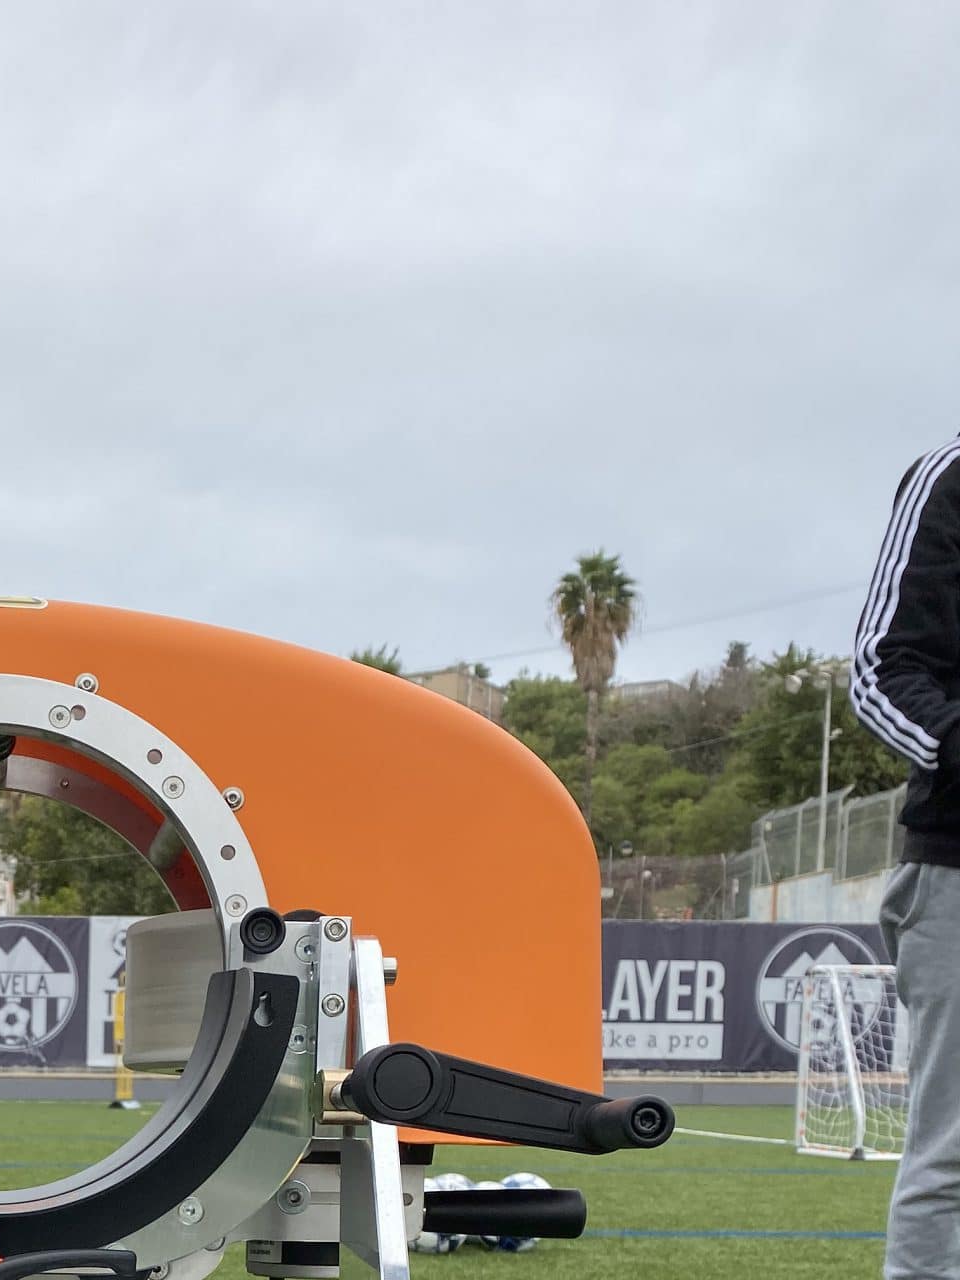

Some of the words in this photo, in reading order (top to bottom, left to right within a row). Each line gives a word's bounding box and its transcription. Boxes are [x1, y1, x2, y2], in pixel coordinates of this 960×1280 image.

[602, 959, 726, 1022] AYER
[647, 1034, 658, 1049] a
[669, 1034, 709, 1054] pro
